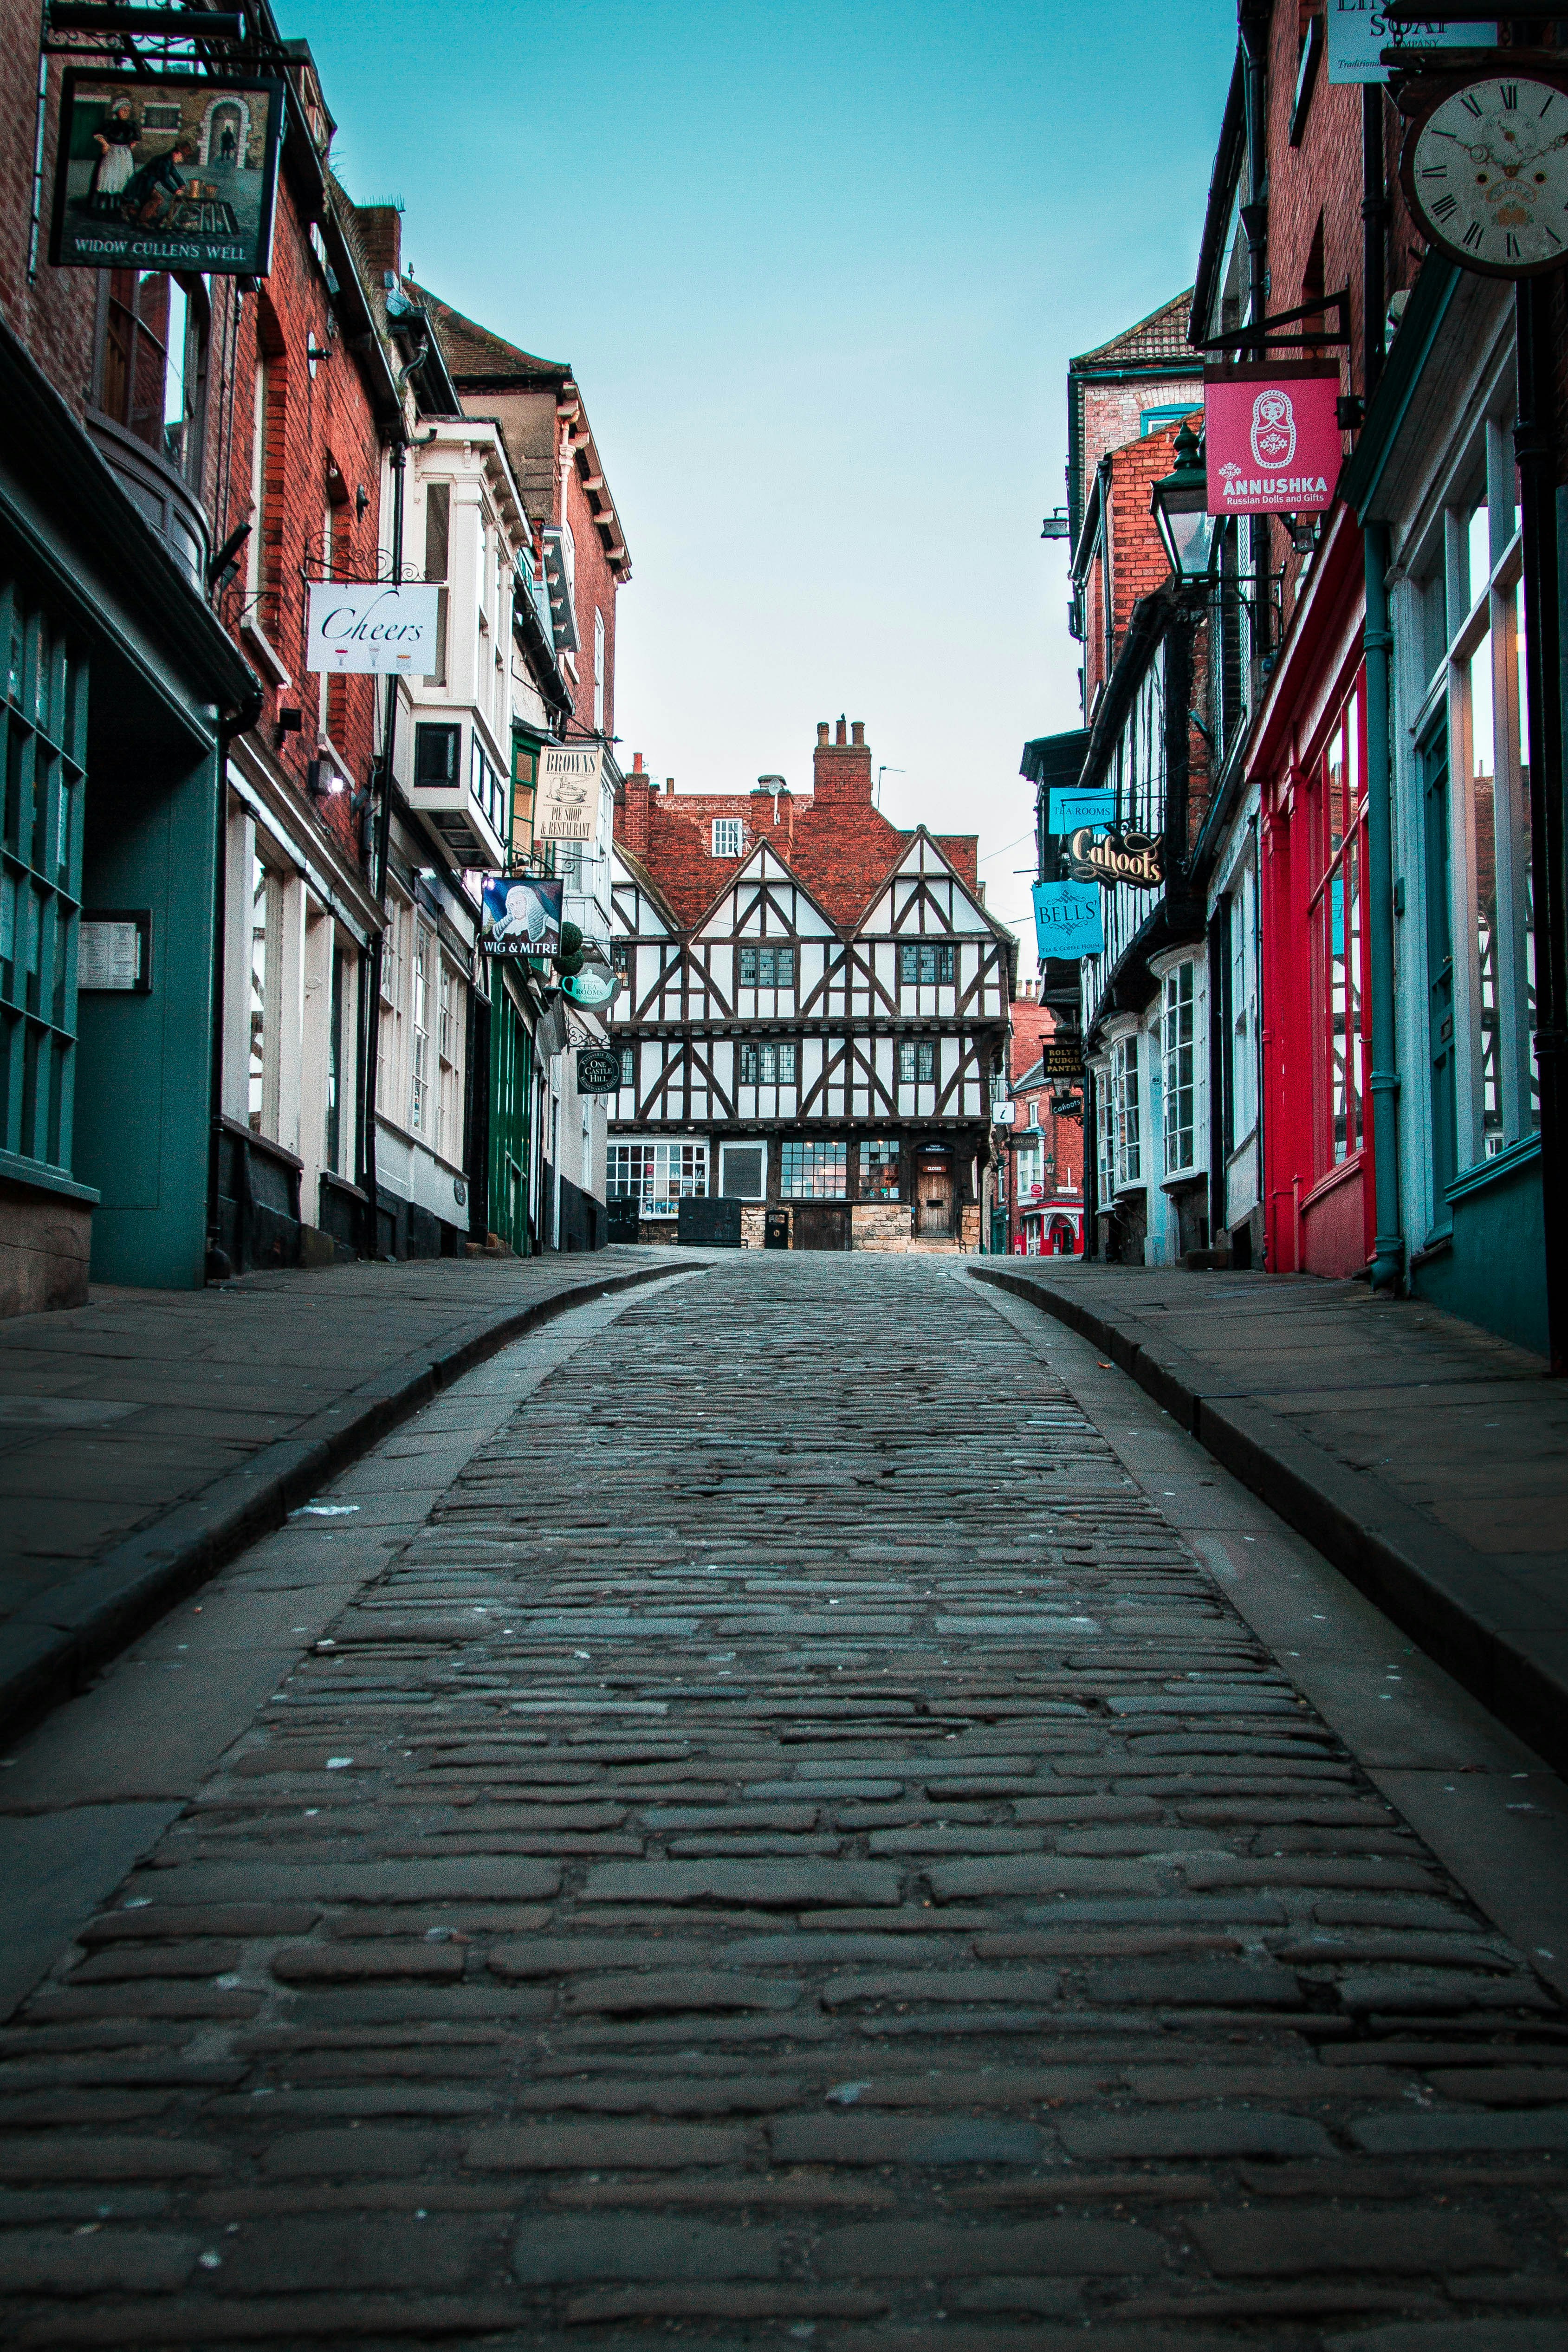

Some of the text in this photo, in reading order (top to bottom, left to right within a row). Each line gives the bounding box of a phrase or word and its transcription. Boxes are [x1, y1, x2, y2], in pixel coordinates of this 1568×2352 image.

[75, 239, 128, 253] WIDOW
[205, 246, 246, 259] WELL
[1223, 477, 1328, 496] ANNUSHKA
[1227, 493, 1324, 505] Russian Dolls and Gifts
[321, 590, 423, 641] Cheers
[546, 753, 596, 773] BROWNS
[551, 807, 582, 821] PIE SHOP
[541, 821, 590, 836] & RESTAURANT
[1073, 828, 1162, 881] Cahoots
[1039, 900, 1097, 924] BELLS'
[484, 942, 558, 954] WIG & MITRE
[605, 1054, 616, 1063] DELI
[1053, 1100, 1081, 1113] Cahoots
